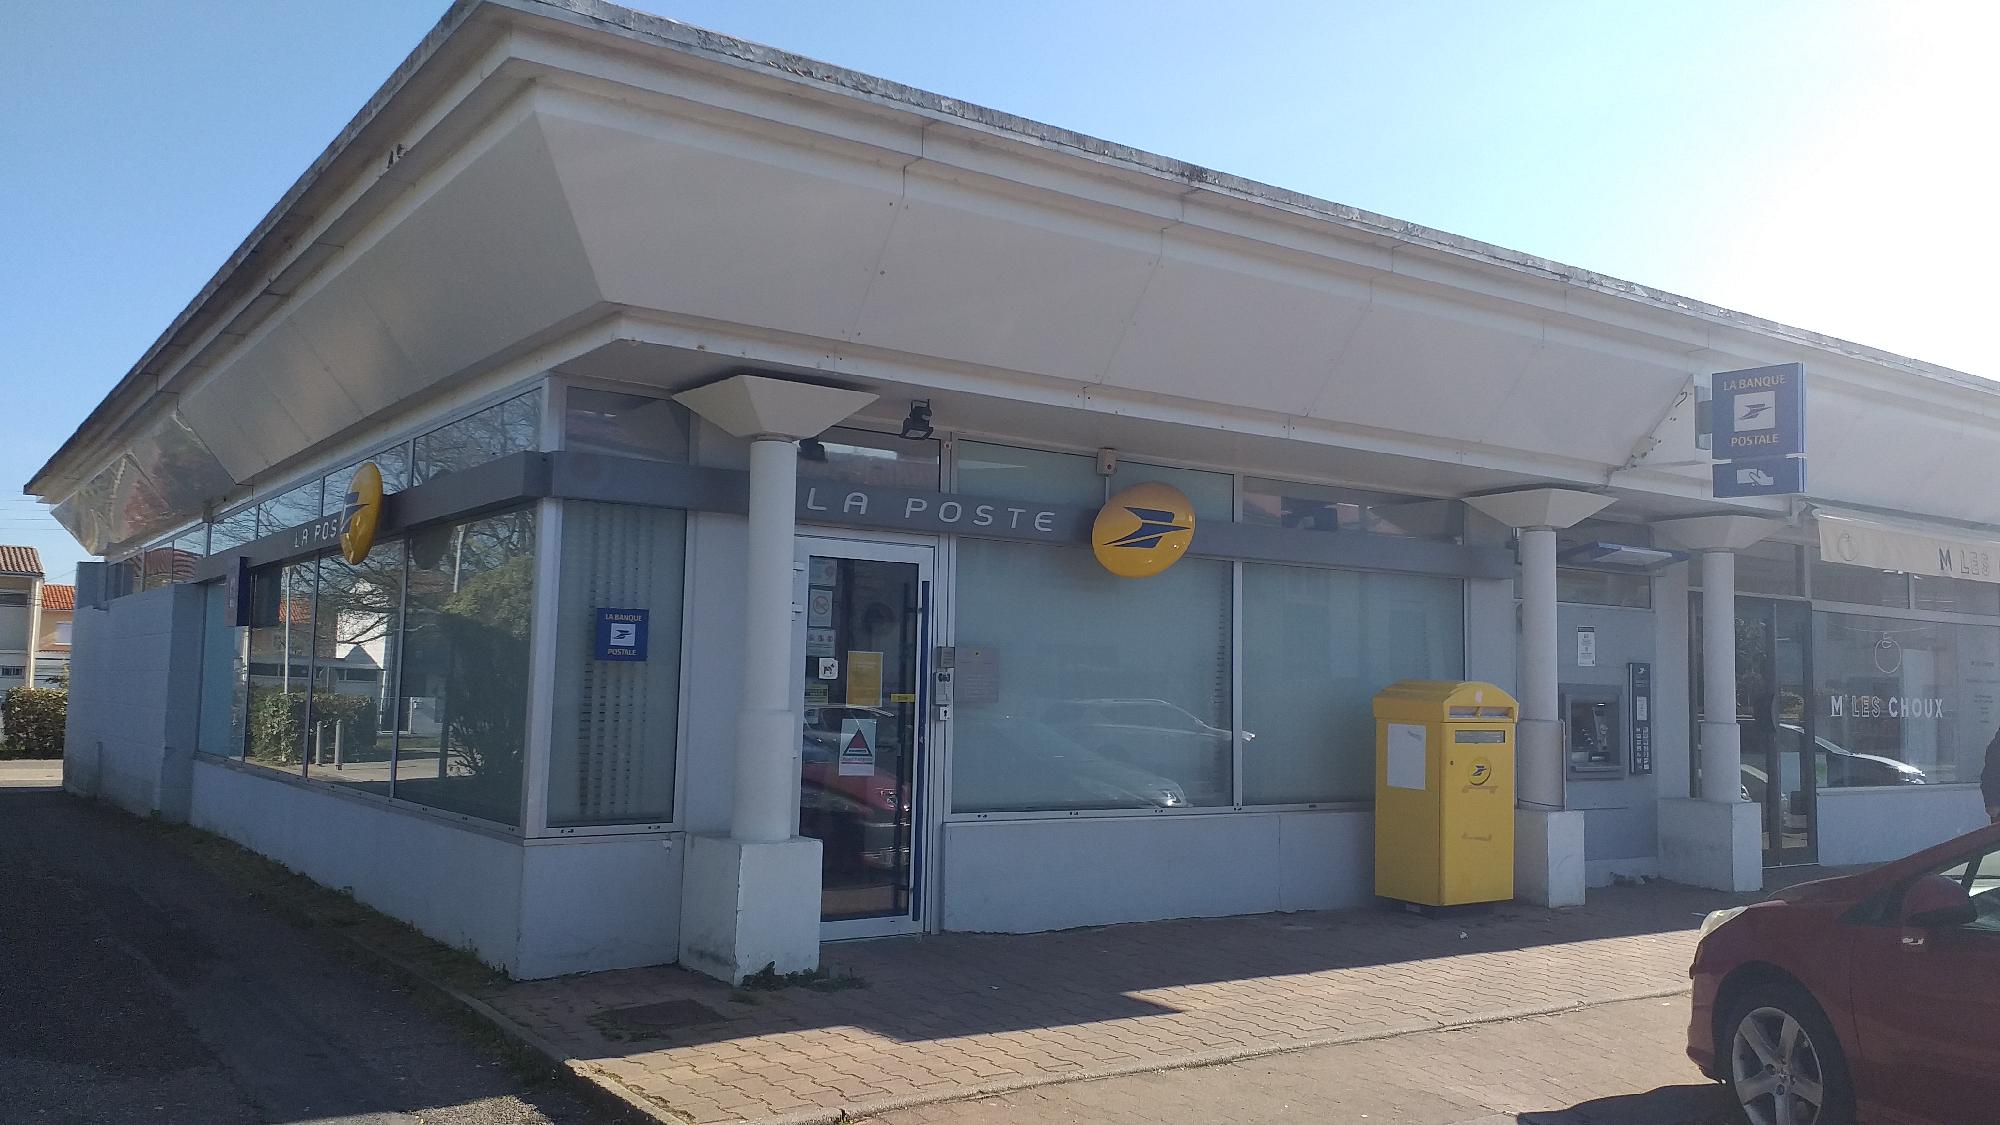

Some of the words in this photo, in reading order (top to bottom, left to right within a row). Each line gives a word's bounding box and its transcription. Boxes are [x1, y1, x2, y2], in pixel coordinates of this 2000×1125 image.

[1723, 380, 1737, 391] LA
[1738, 374, 1786, 390] BANQUE
[1731, 433, 1779, 447] POSTALE
[806, 487, 868, 515] LA
[904, 497, 1057, 532] POSTE
[295, 528, 310, 548] LA
[315, 519, 337, 541] POS
[1960, 550, 1989, 576] LES
[614, 614, 642, 622] BANQUE
[607, 648, 637, 656] POSTALE
[1851, 696, 1881, 718] LES
[1888, 697, 1943, 719] CHOUX
